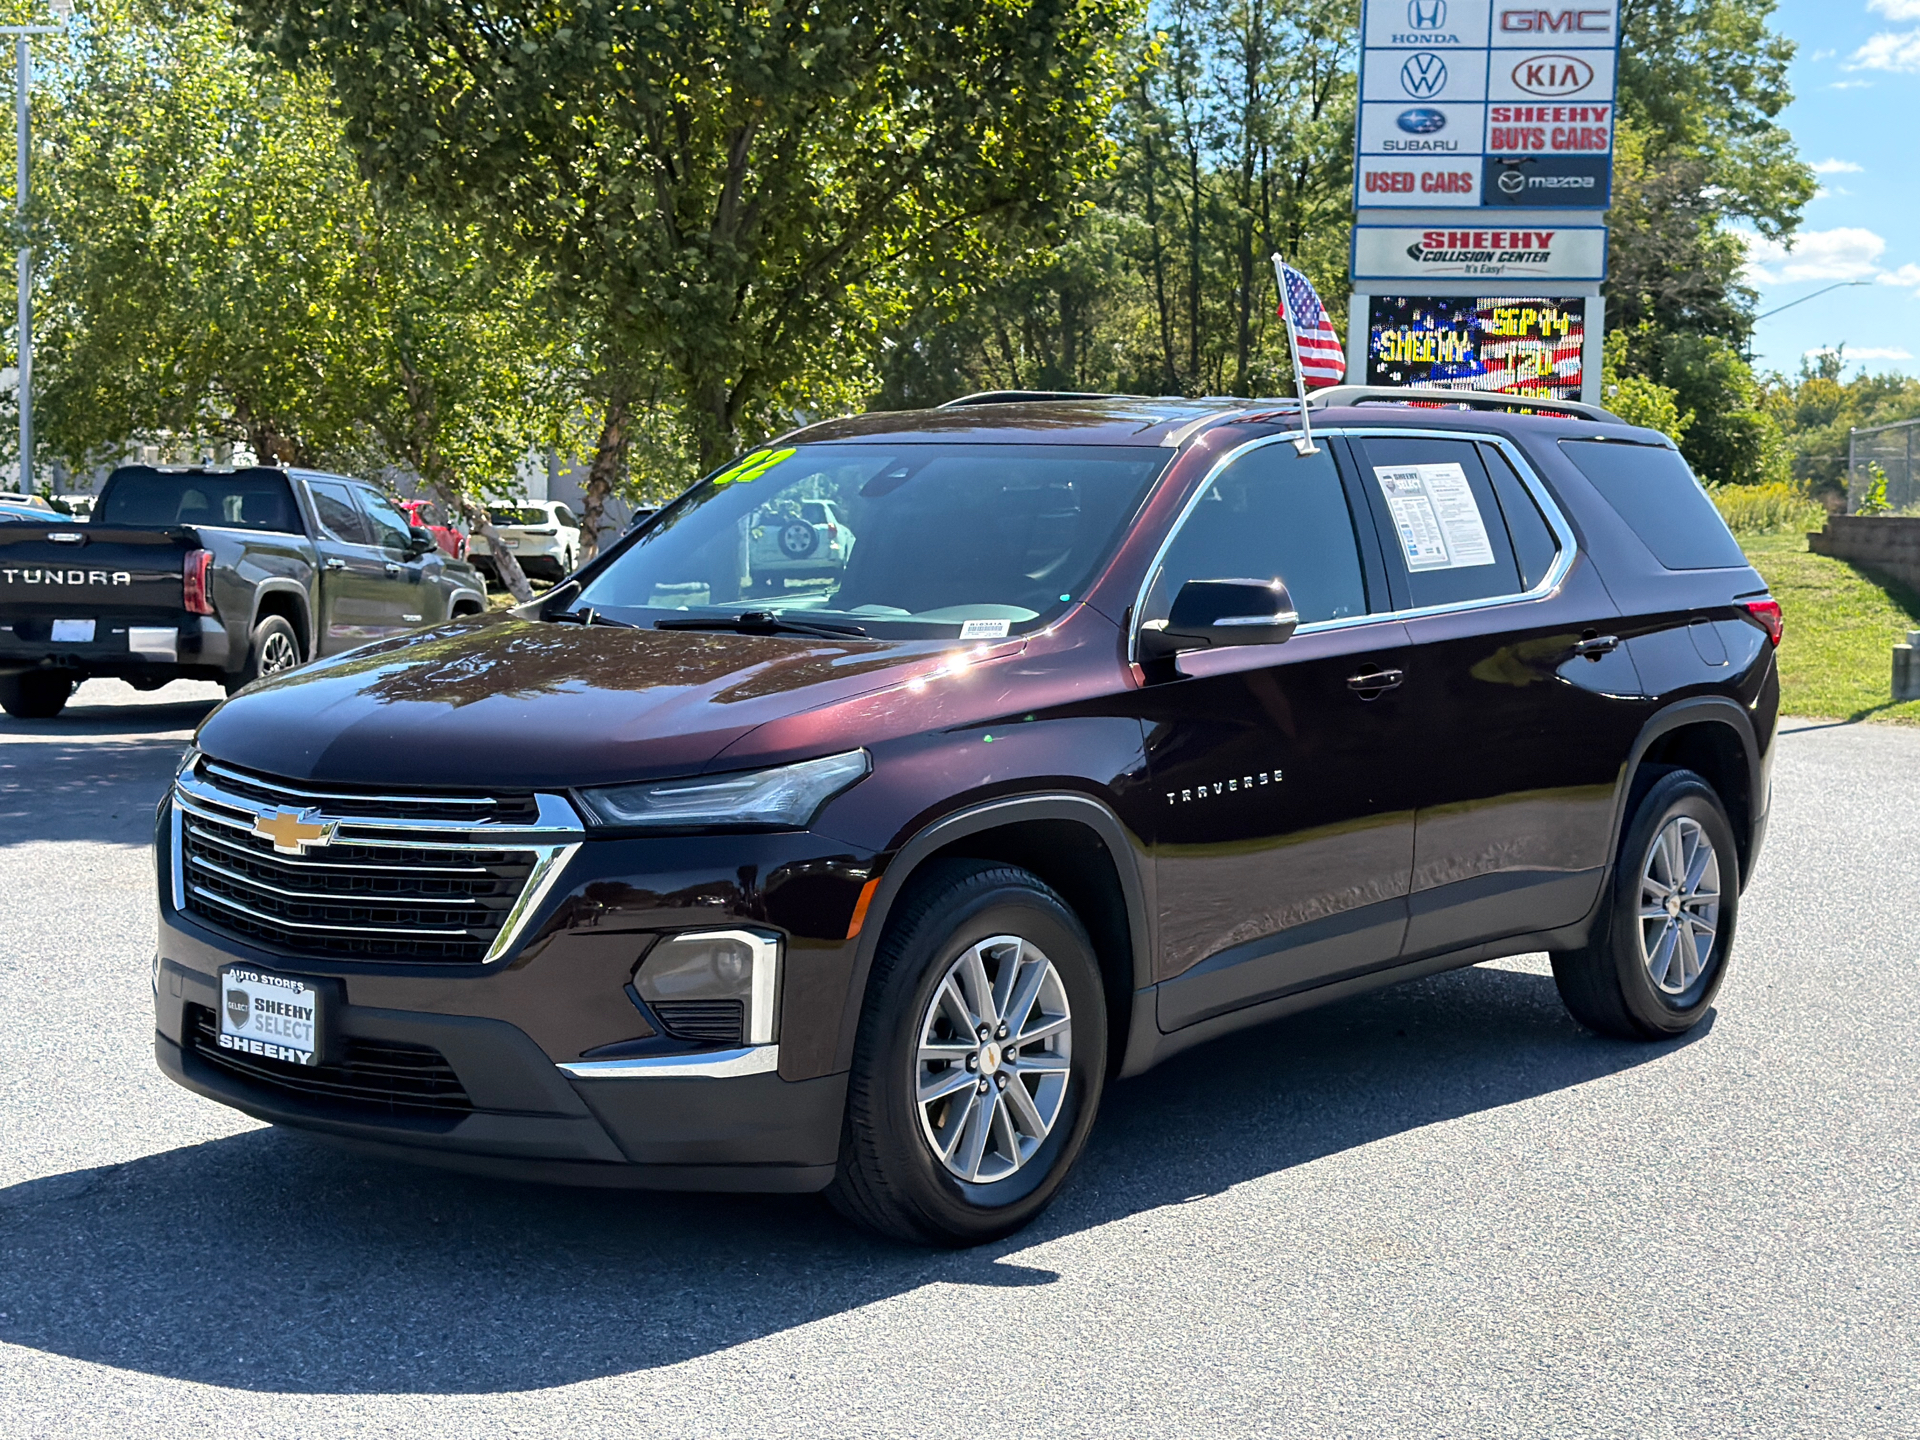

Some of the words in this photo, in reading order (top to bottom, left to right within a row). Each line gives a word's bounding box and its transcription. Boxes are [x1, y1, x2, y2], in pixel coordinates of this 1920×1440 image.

[1501, 9, 1611, 33] GMC
[1391, 34, 1460, 44] HONDA
[1526, 65, 1579, 87] KIA
[1491, 107, 1609, 122] SHEEHY
[1383, 140, 1458, 151] SUBARU
[1491, 128, 1545, 150] BUYS
[1551, 127, 1608, 150] CARS
[1365, 172, 1415, 193] USED
[1421, 172, 1473, 194] CARS
[1423, 232, 1555, 249] SHEEHY
[1422, 251, 1494, 263] COLLISION
[1497, 251, 1551, 263] CENTER
[1464, 264, 1478, 273] It's
[1480, 265, 1506, 275] Easy!
[1380, 330, 1468, 361] SHEEHY
[2, 569, 131, 586] TUNDRA
[1166, 769, 1283, 805] TRAVERSE
[229, 969, 259, 982] AUTO
[261, 974, 305, 991] STORES
[228, 1001, 249, 1012] SELECT
[254, 997, 313, 1021] SHEEHY
[255, 1014, 312, 1041] SELECT
[219, 1034, 312, 1065] SHEEHY
